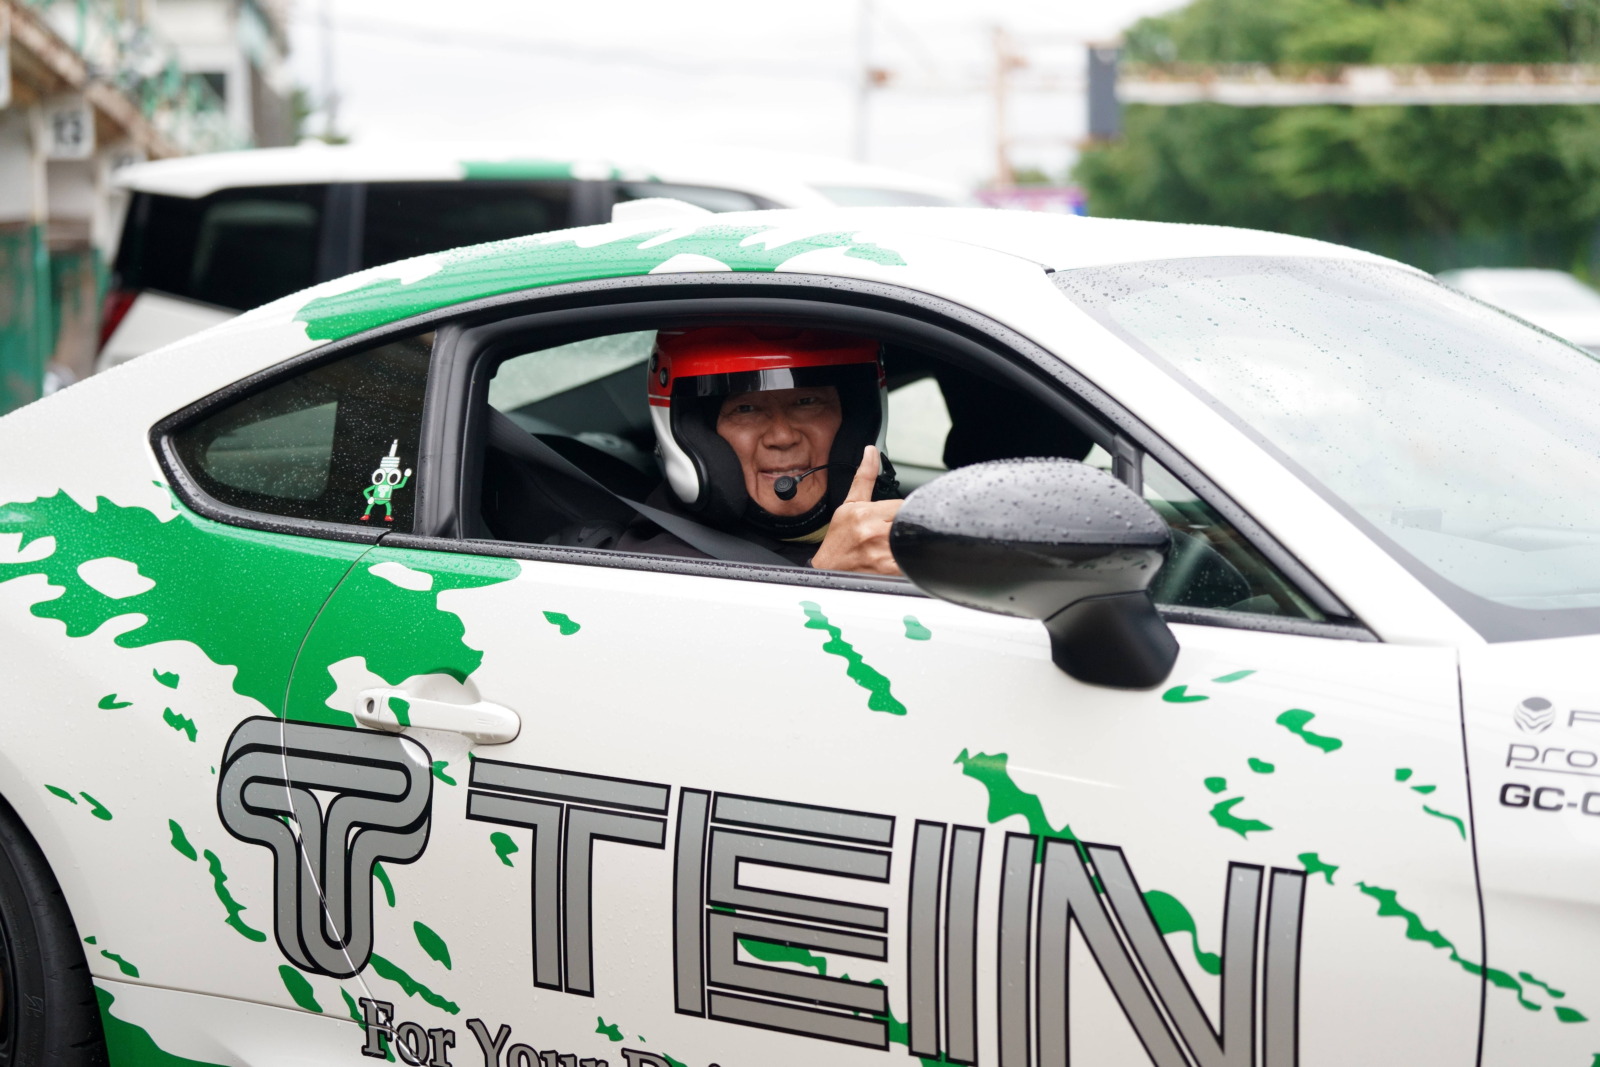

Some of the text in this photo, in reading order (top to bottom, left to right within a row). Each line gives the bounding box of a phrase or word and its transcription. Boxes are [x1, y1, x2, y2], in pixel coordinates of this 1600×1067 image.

[466, 756, 1308, 1067] TEIN
[359, 997, 608, 1067] For Yo
